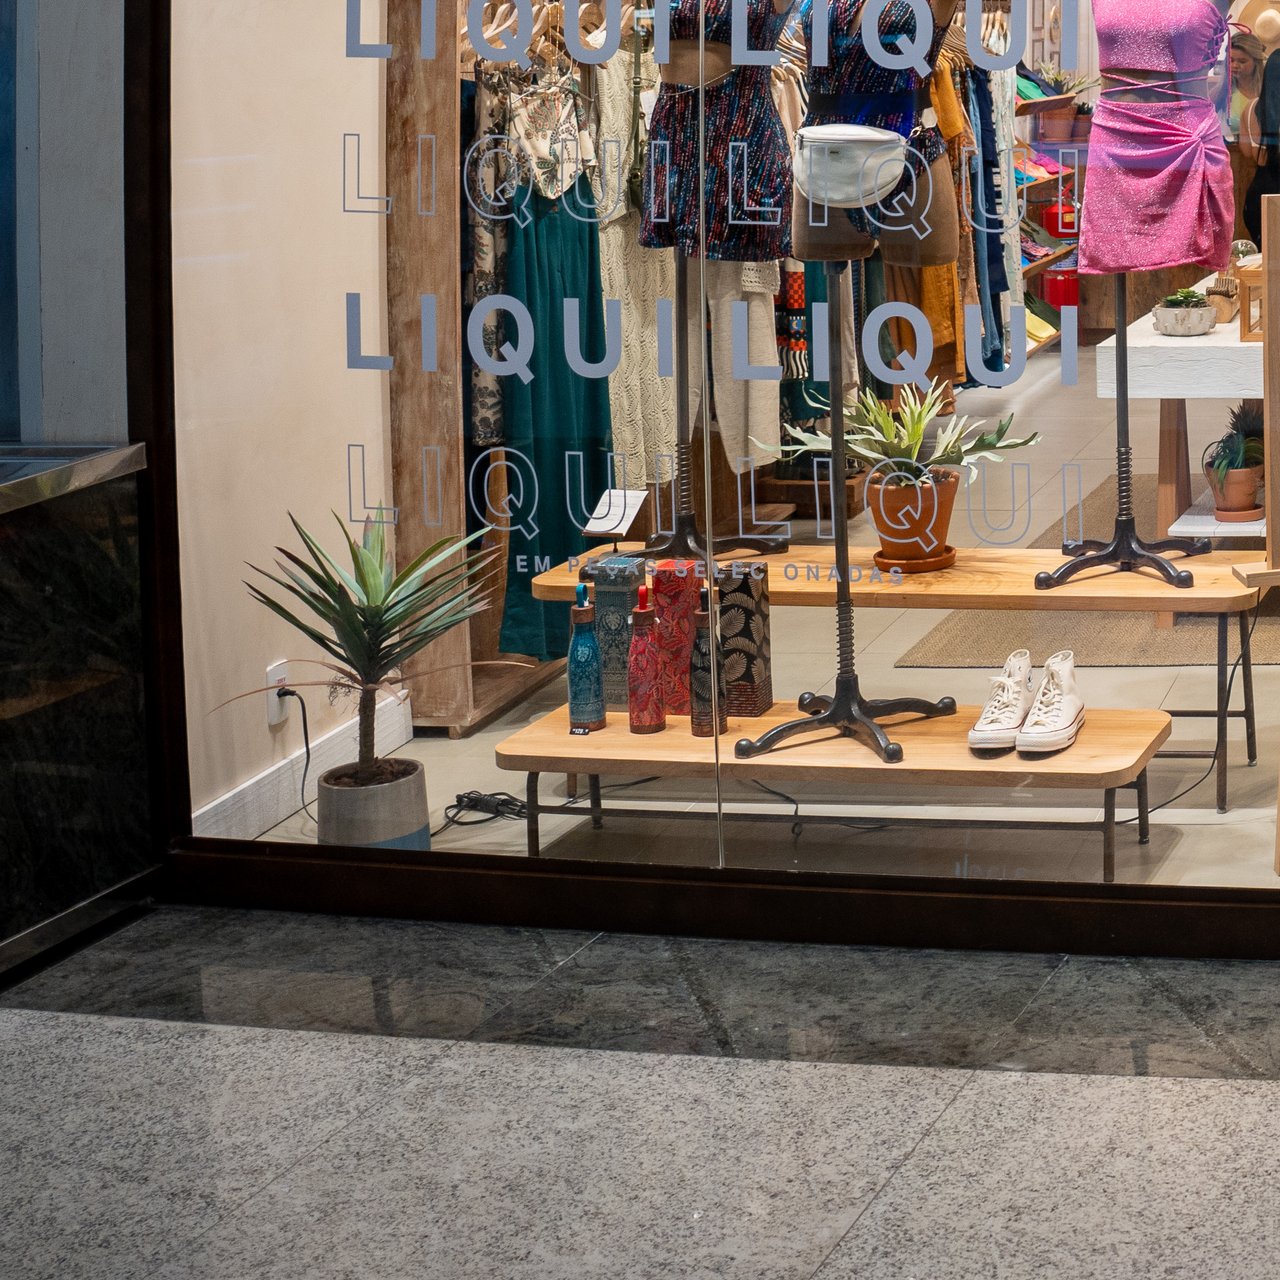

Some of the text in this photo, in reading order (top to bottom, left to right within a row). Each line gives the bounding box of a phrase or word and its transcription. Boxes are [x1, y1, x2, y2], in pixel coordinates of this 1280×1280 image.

[515, 554, 903, 585] EM PEÇAS SELECONADAS
